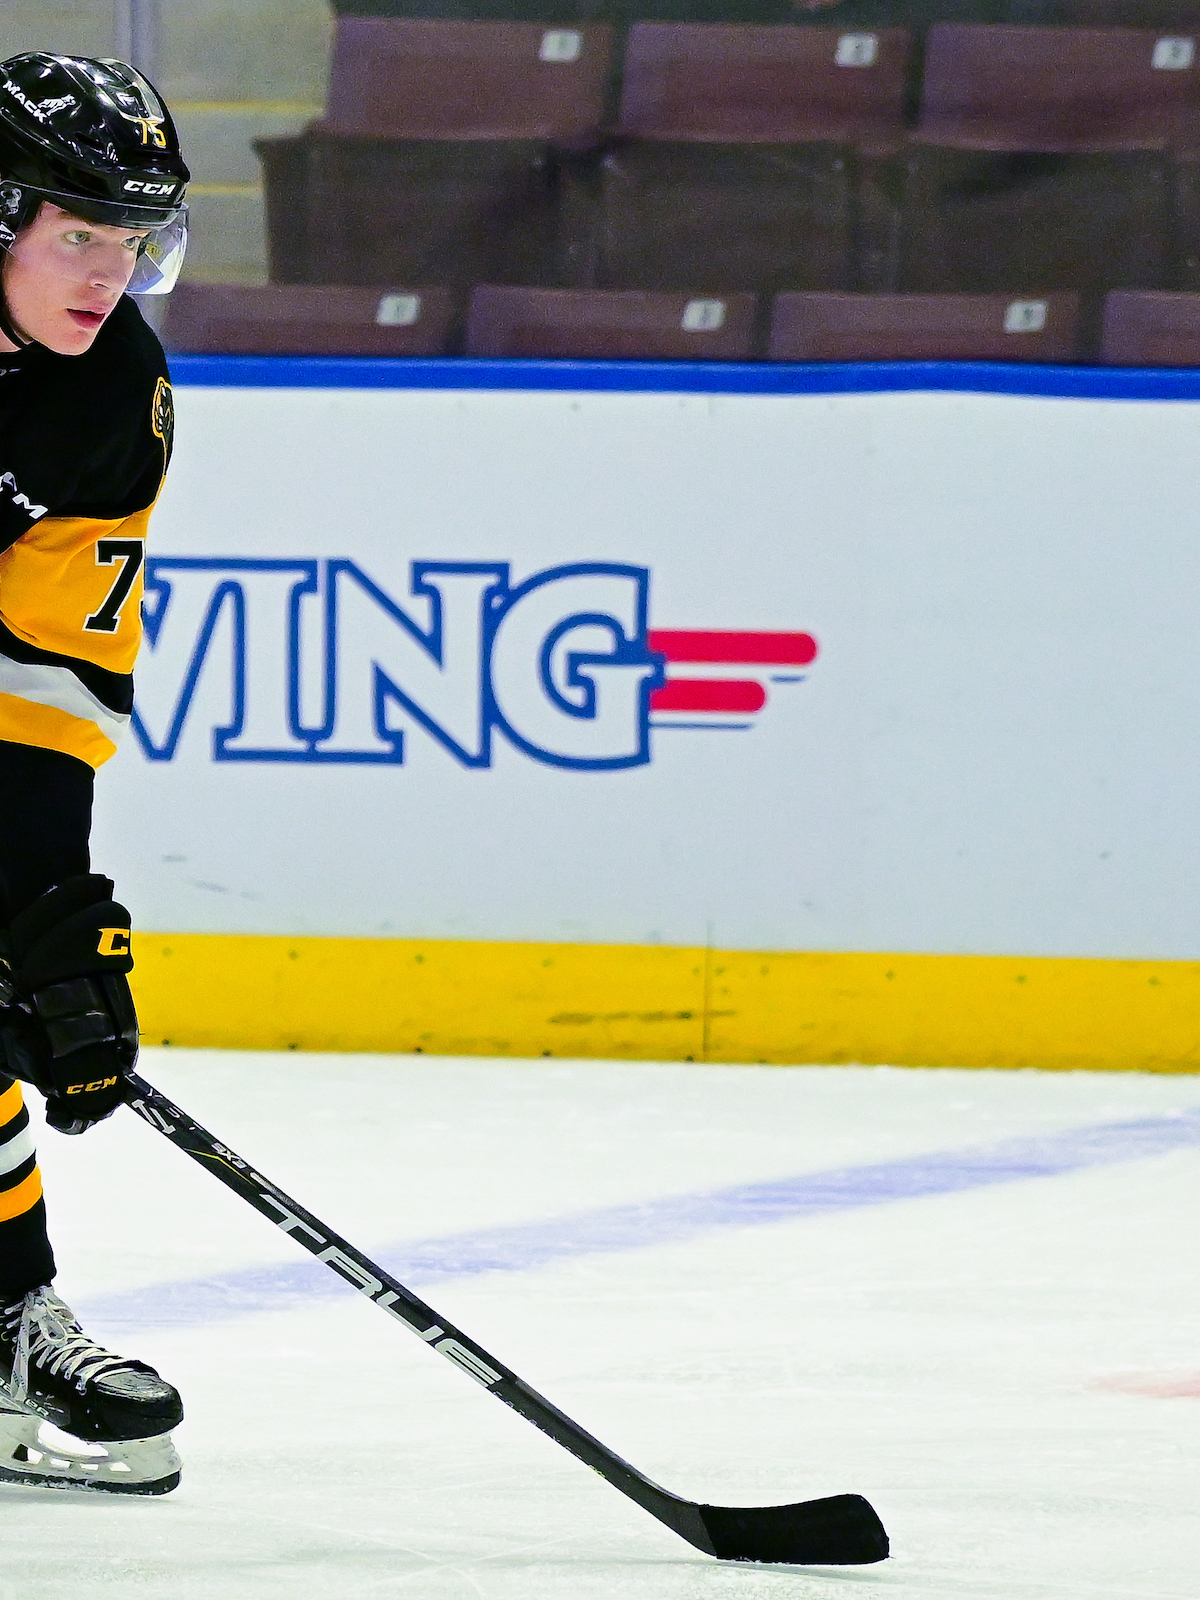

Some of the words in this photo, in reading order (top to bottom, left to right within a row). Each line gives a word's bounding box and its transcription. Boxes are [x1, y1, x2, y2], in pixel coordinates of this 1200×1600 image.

[3, 80, 47, 124] MACK
[134, 118, 166, 148] 75
[122, 179, 176, 197] CCM
[82, 537, 147, 634] 7
[66, 1075, 118, 1095] CCM
[259, 1192, 503, 1389] TRUE
